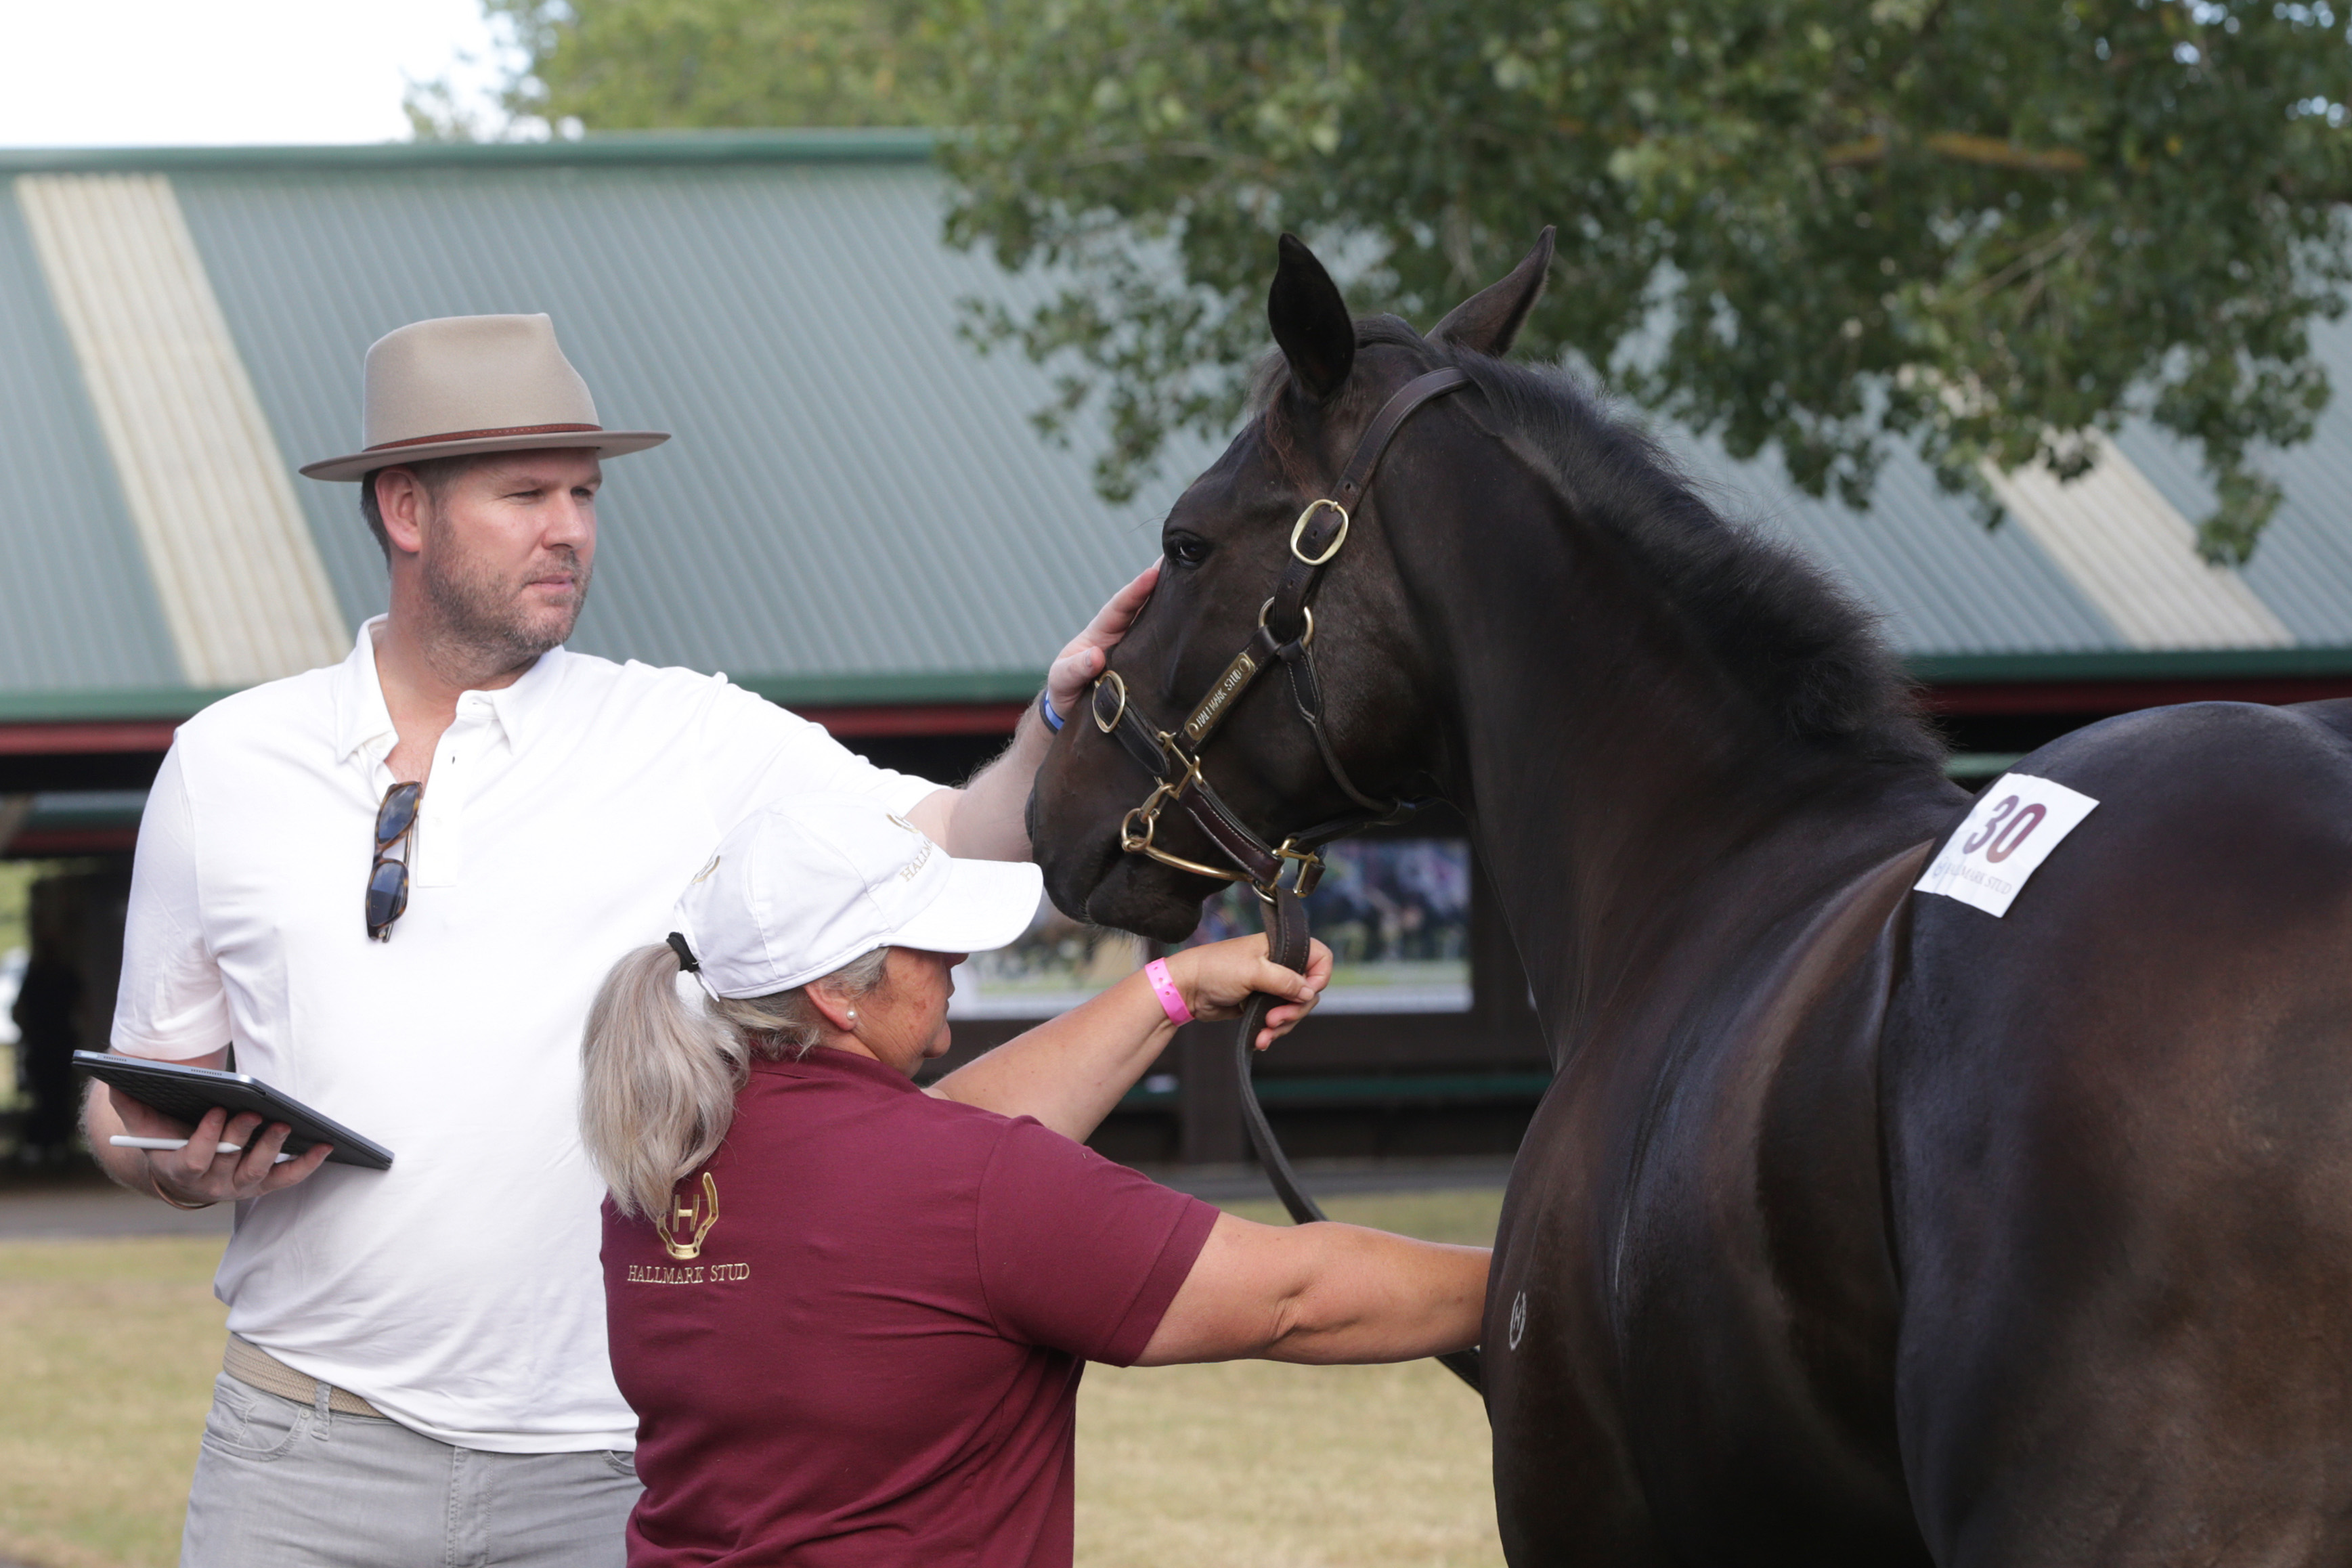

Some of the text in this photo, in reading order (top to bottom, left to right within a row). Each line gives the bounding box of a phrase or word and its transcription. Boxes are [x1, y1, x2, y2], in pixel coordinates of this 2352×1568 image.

[1224, 669, 1242, 691] STUD
[1962, 795, 2047, 863] 30
[899, 840, 932, 882] HALLM
[1984, 875, 2012, 894] STUD
[672, 1194, 699, 1232] H
[627, 1263, 750, 1284] HALLMARK STUD
